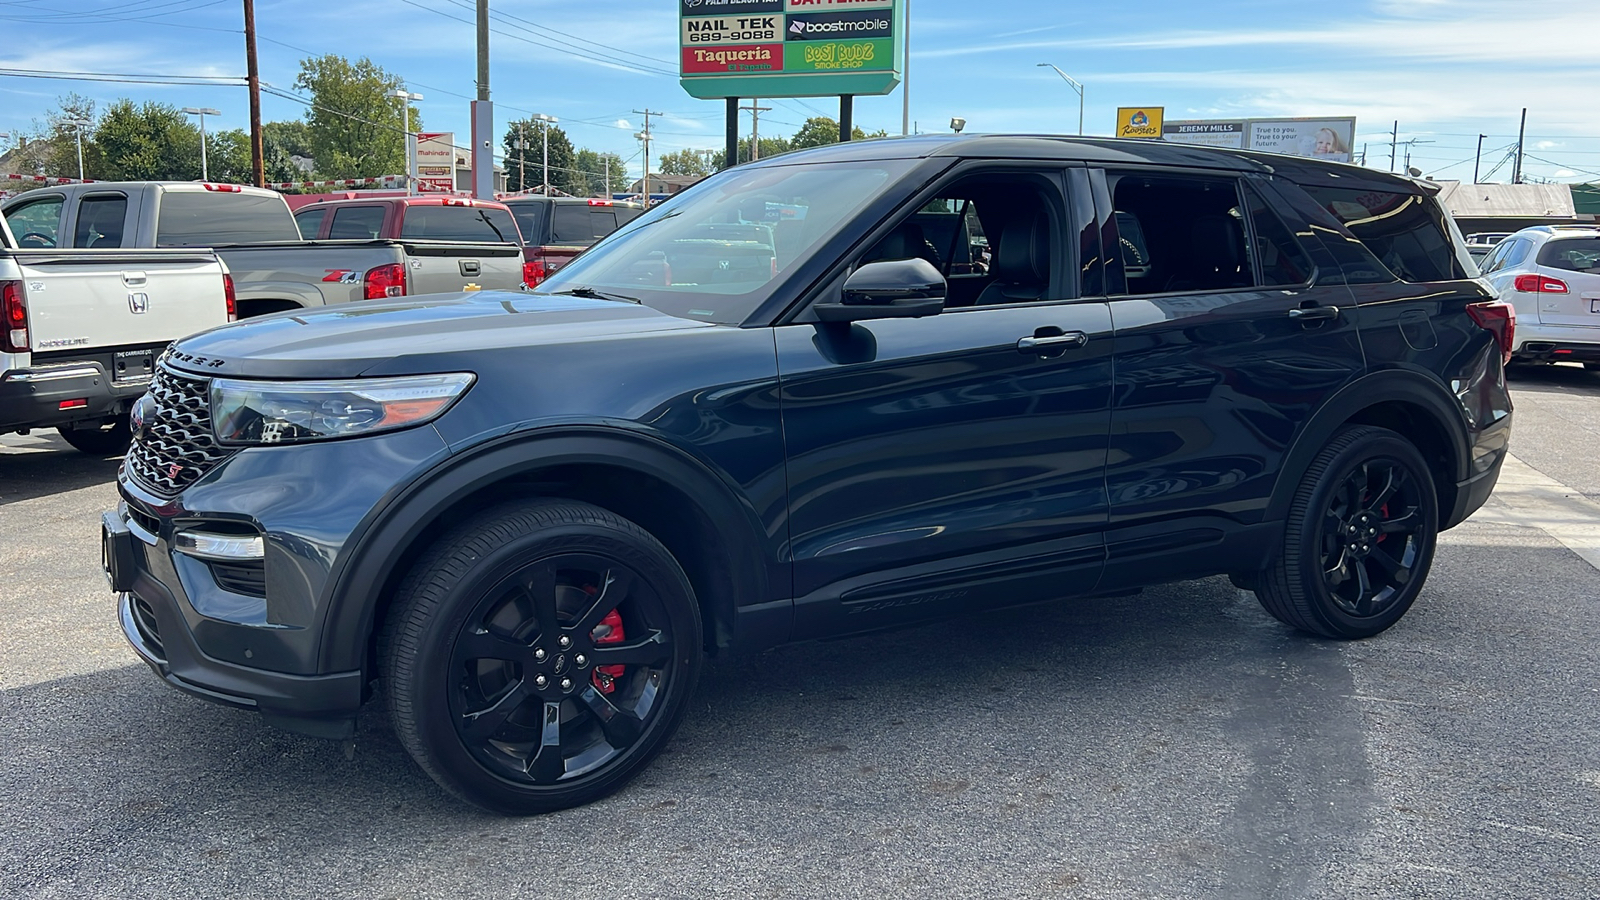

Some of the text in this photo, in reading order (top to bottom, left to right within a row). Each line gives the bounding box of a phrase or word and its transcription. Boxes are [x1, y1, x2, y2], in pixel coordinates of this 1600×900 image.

[687, 17, 775, 32] NAIL TEK
[806, 19, 888, 33] boostmobile
[689, 30, 774, 42] 689-9088
[694, 46, 771, 64] Taquería
[1122, 124, 1157, 136] Roosters
[1178, 124, 1234, 133] JEREMY MILLS
